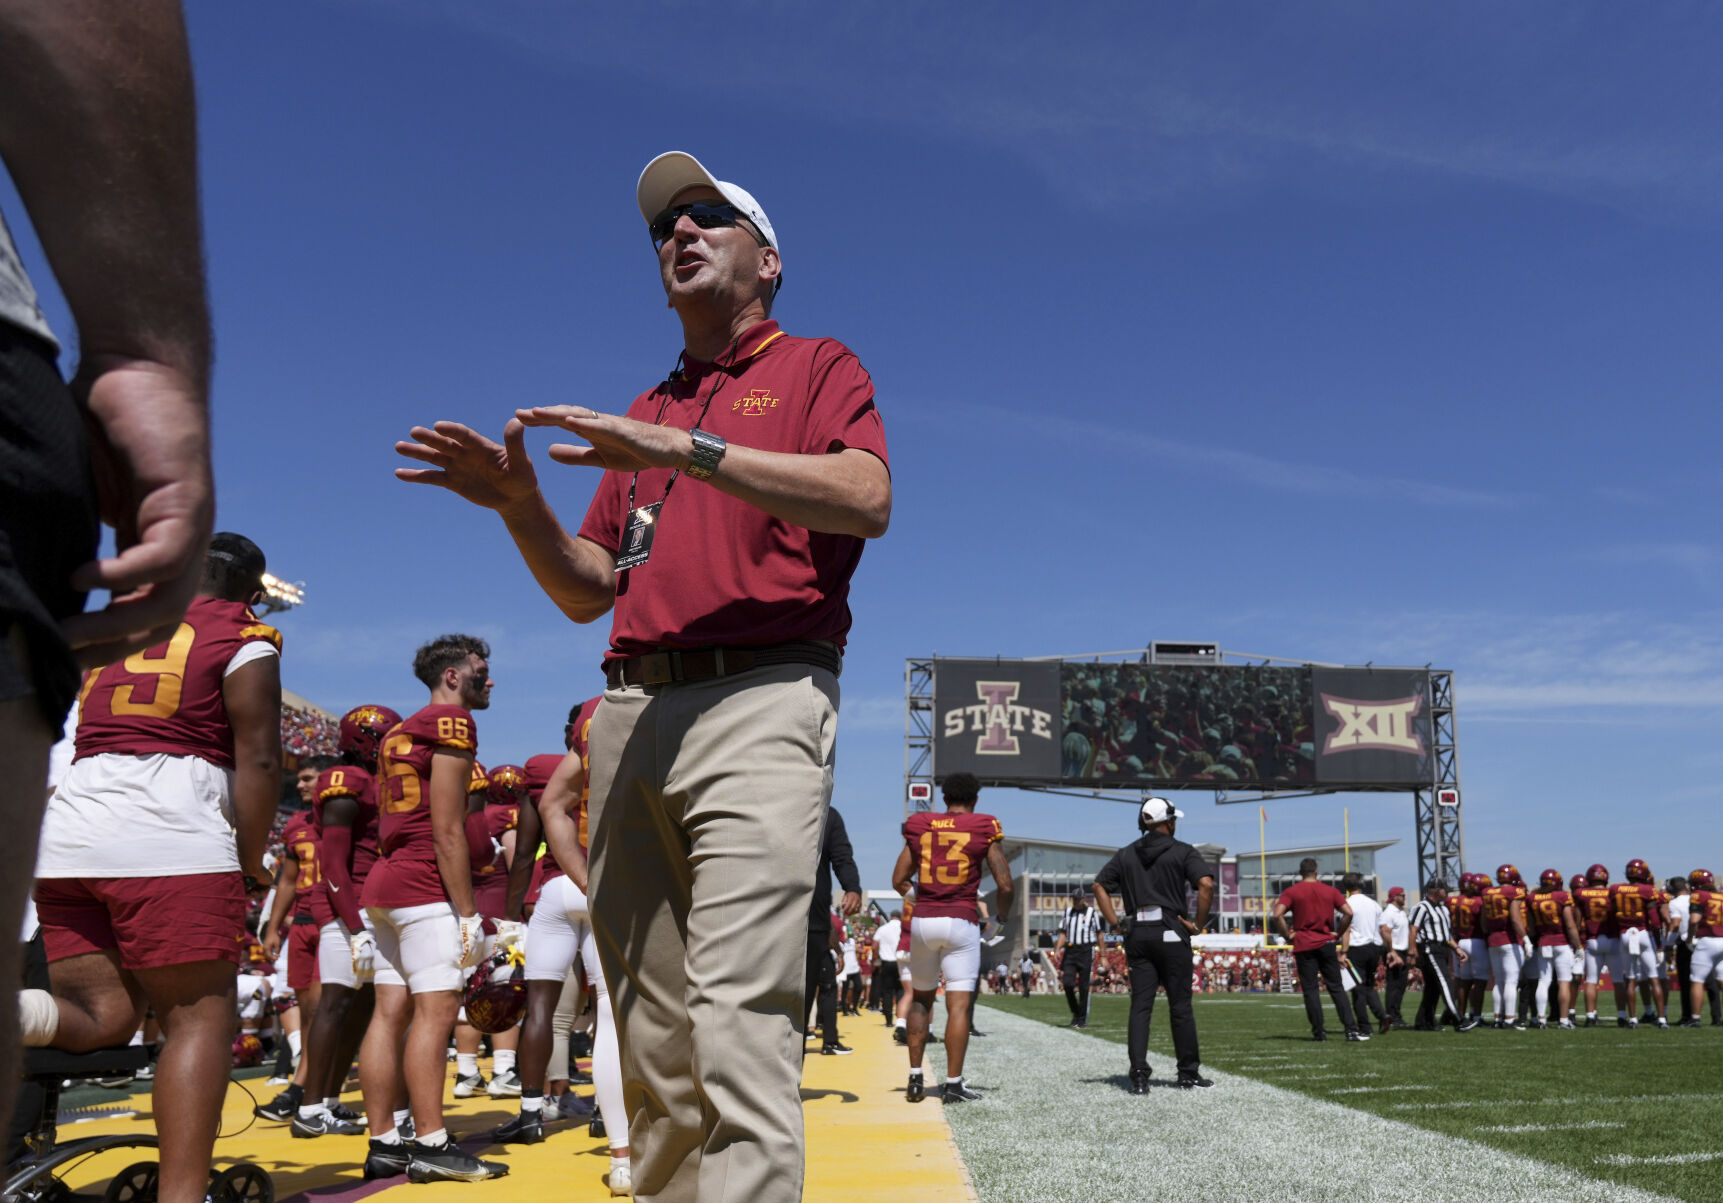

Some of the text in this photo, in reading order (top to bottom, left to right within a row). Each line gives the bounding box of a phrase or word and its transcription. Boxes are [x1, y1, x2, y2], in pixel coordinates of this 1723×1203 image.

[732, 398, 780, 410] STATE
[437, 717, 469, 739] 85
[944, 704, 1052, 739] STATE
[919, 831, 971, 885] 13
